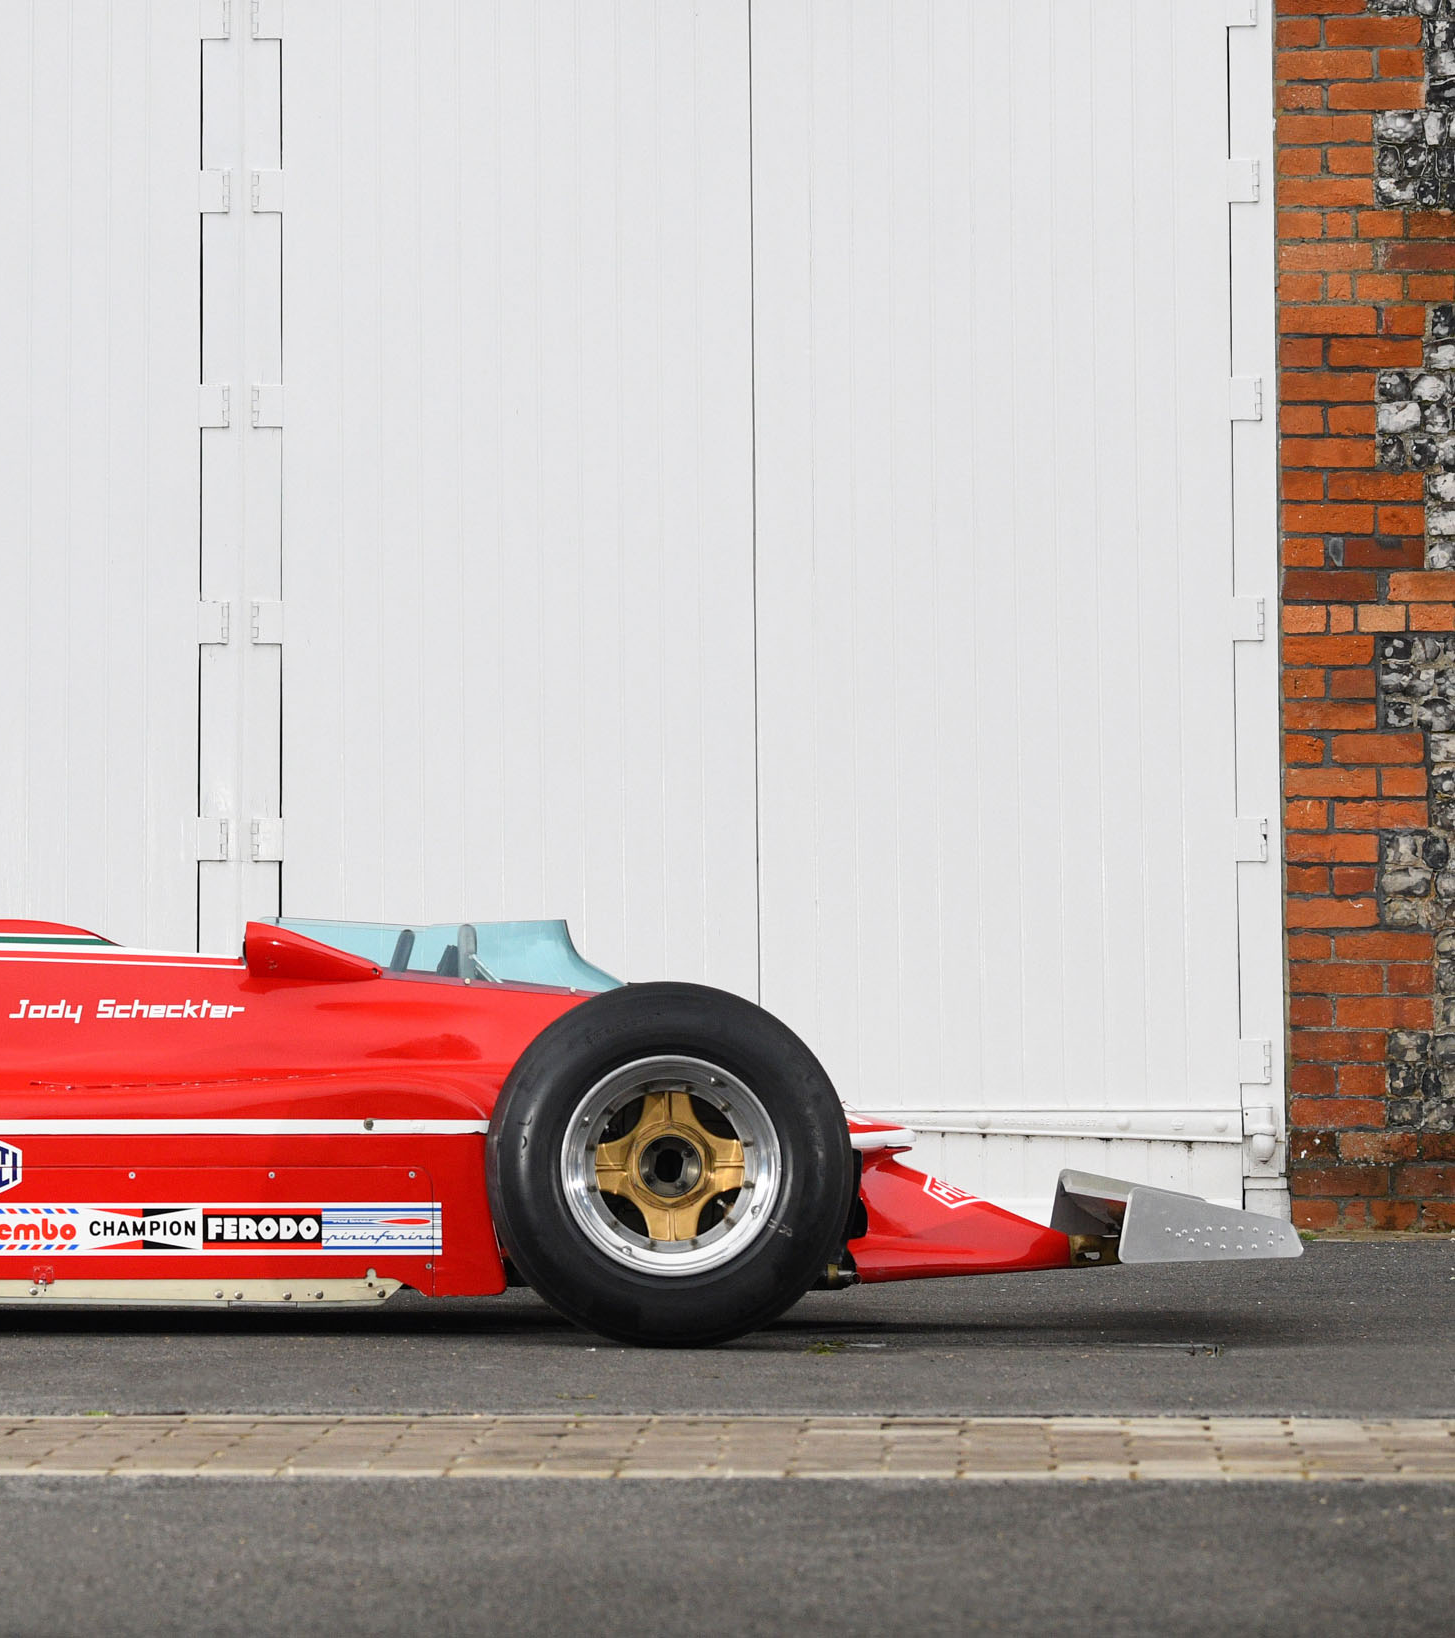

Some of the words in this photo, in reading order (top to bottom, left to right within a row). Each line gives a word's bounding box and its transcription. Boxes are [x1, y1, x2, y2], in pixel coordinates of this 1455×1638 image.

[9, 1000, 83, 1024] Jody
[96, 1000, 245, 1019] Scheckter
[90, 1220, 196, 1236] CHAMPION
[208, 1217, 320, 1240] FERODO
